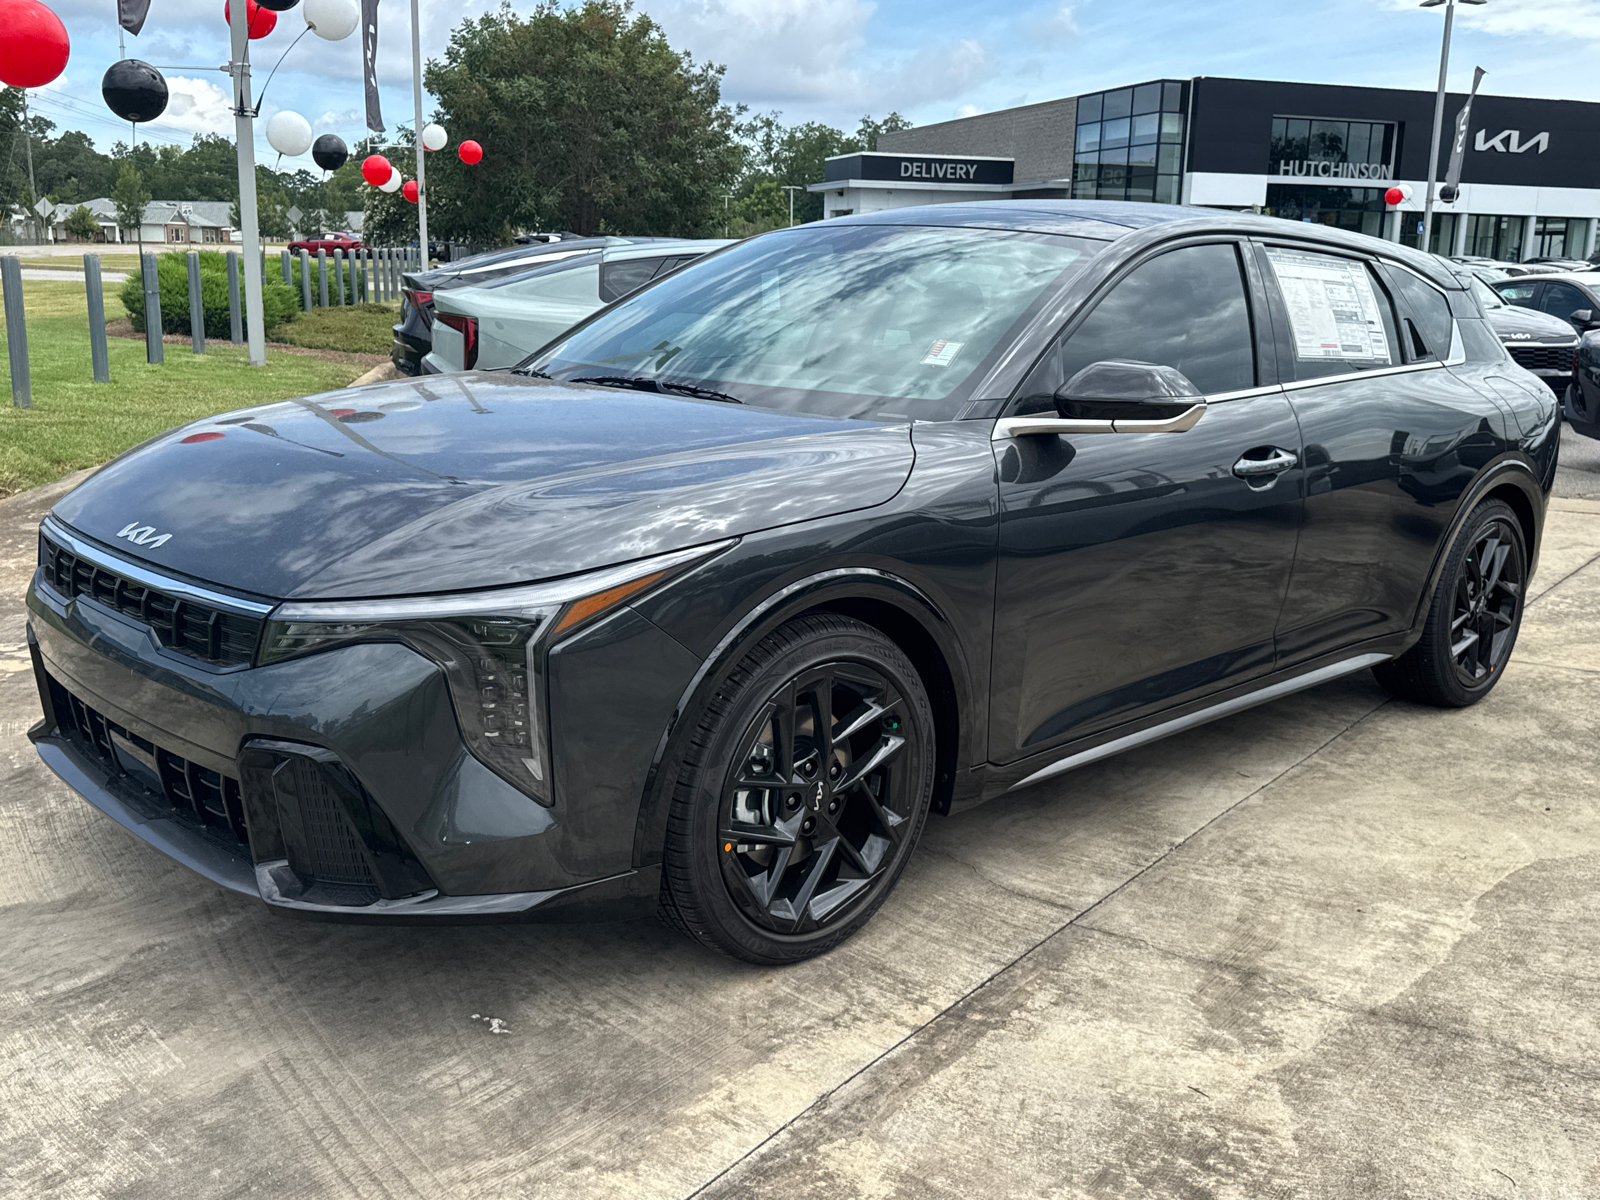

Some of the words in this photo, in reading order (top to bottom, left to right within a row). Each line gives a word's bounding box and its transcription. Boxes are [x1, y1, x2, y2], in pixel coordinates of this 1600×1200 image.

[1474, 128, 1550, 154] KIA
[900, 161, 978, 180] DELIVERY
[1279, 159, 1393, 181] HUTCHINSON
[116, 521, 173, 549] KIA
[813, 781, 824, 811] KIA
